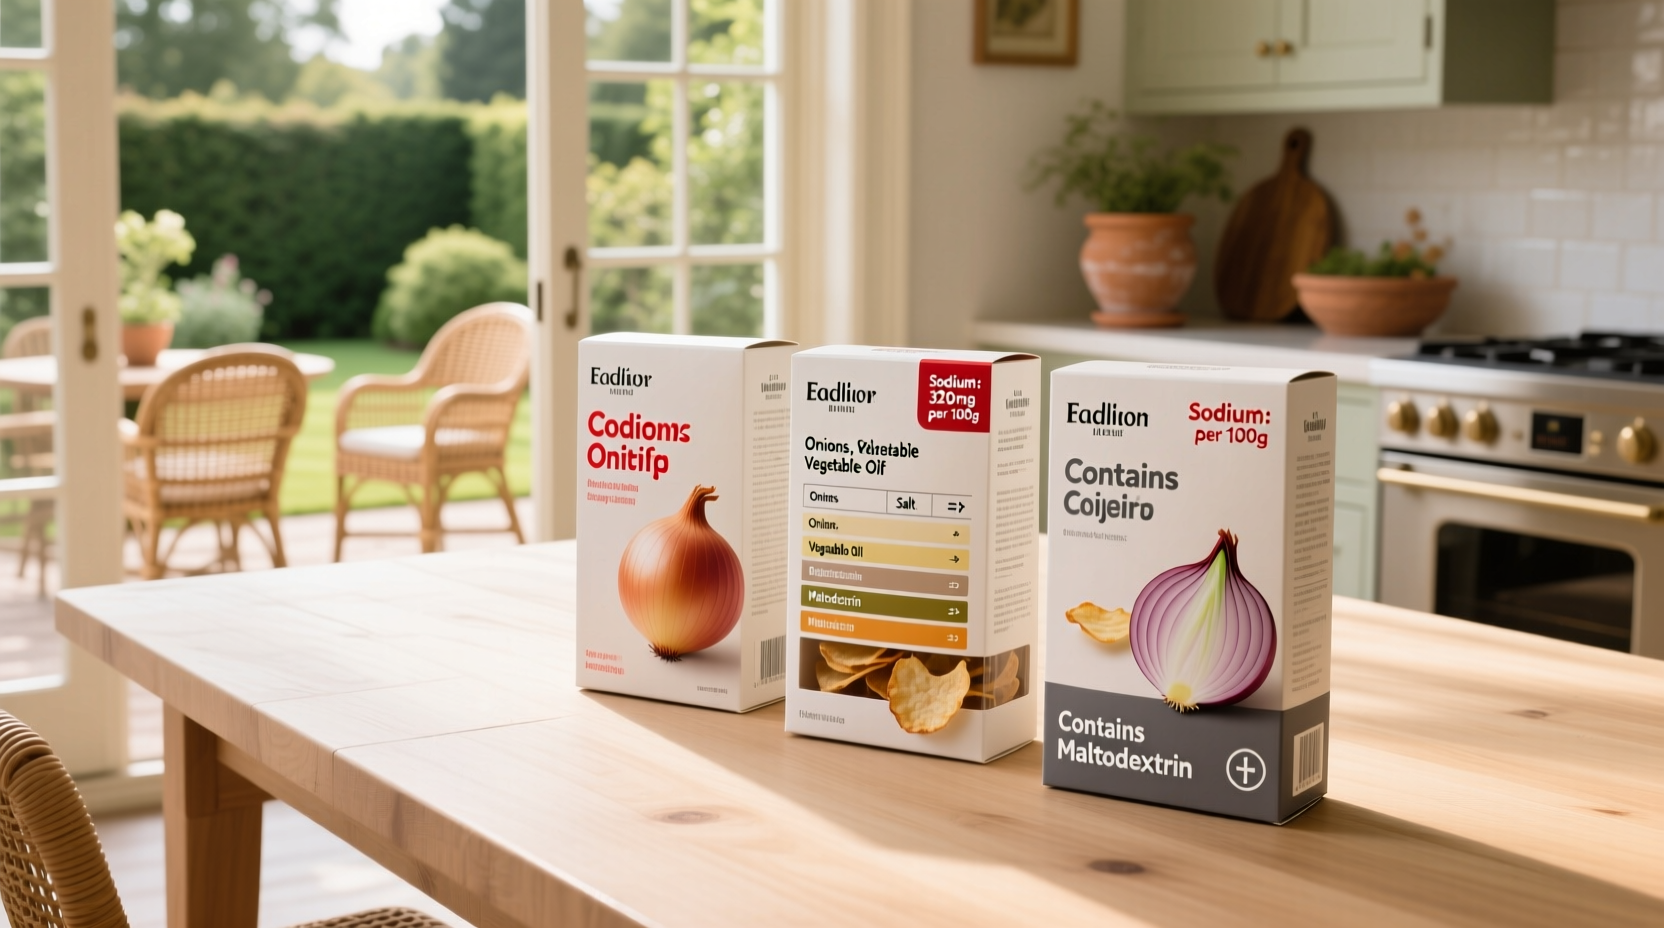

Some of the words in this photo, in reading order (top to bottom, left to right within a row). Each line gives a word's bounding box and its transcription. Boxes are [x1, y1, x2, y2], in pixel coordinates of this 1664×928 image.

[929, 374, 981, 389] Sodium:
[929, 389, 976, 408] 320mg
[928, 409, 949, 423] per
[951, 408, 980, 424] 100g
[1188, 401, 1271, 425] Sodium:
[805, 436, 854, 456] Onions,
[1194, 429, 1223, 446] per
[1226, 426, 1268, 449] 100g
[1064, 457, 1179, 491] Contains
[1058, 710, 1145, 743] Contains
[1058, 738, 1193, 779] Maltodextrin
